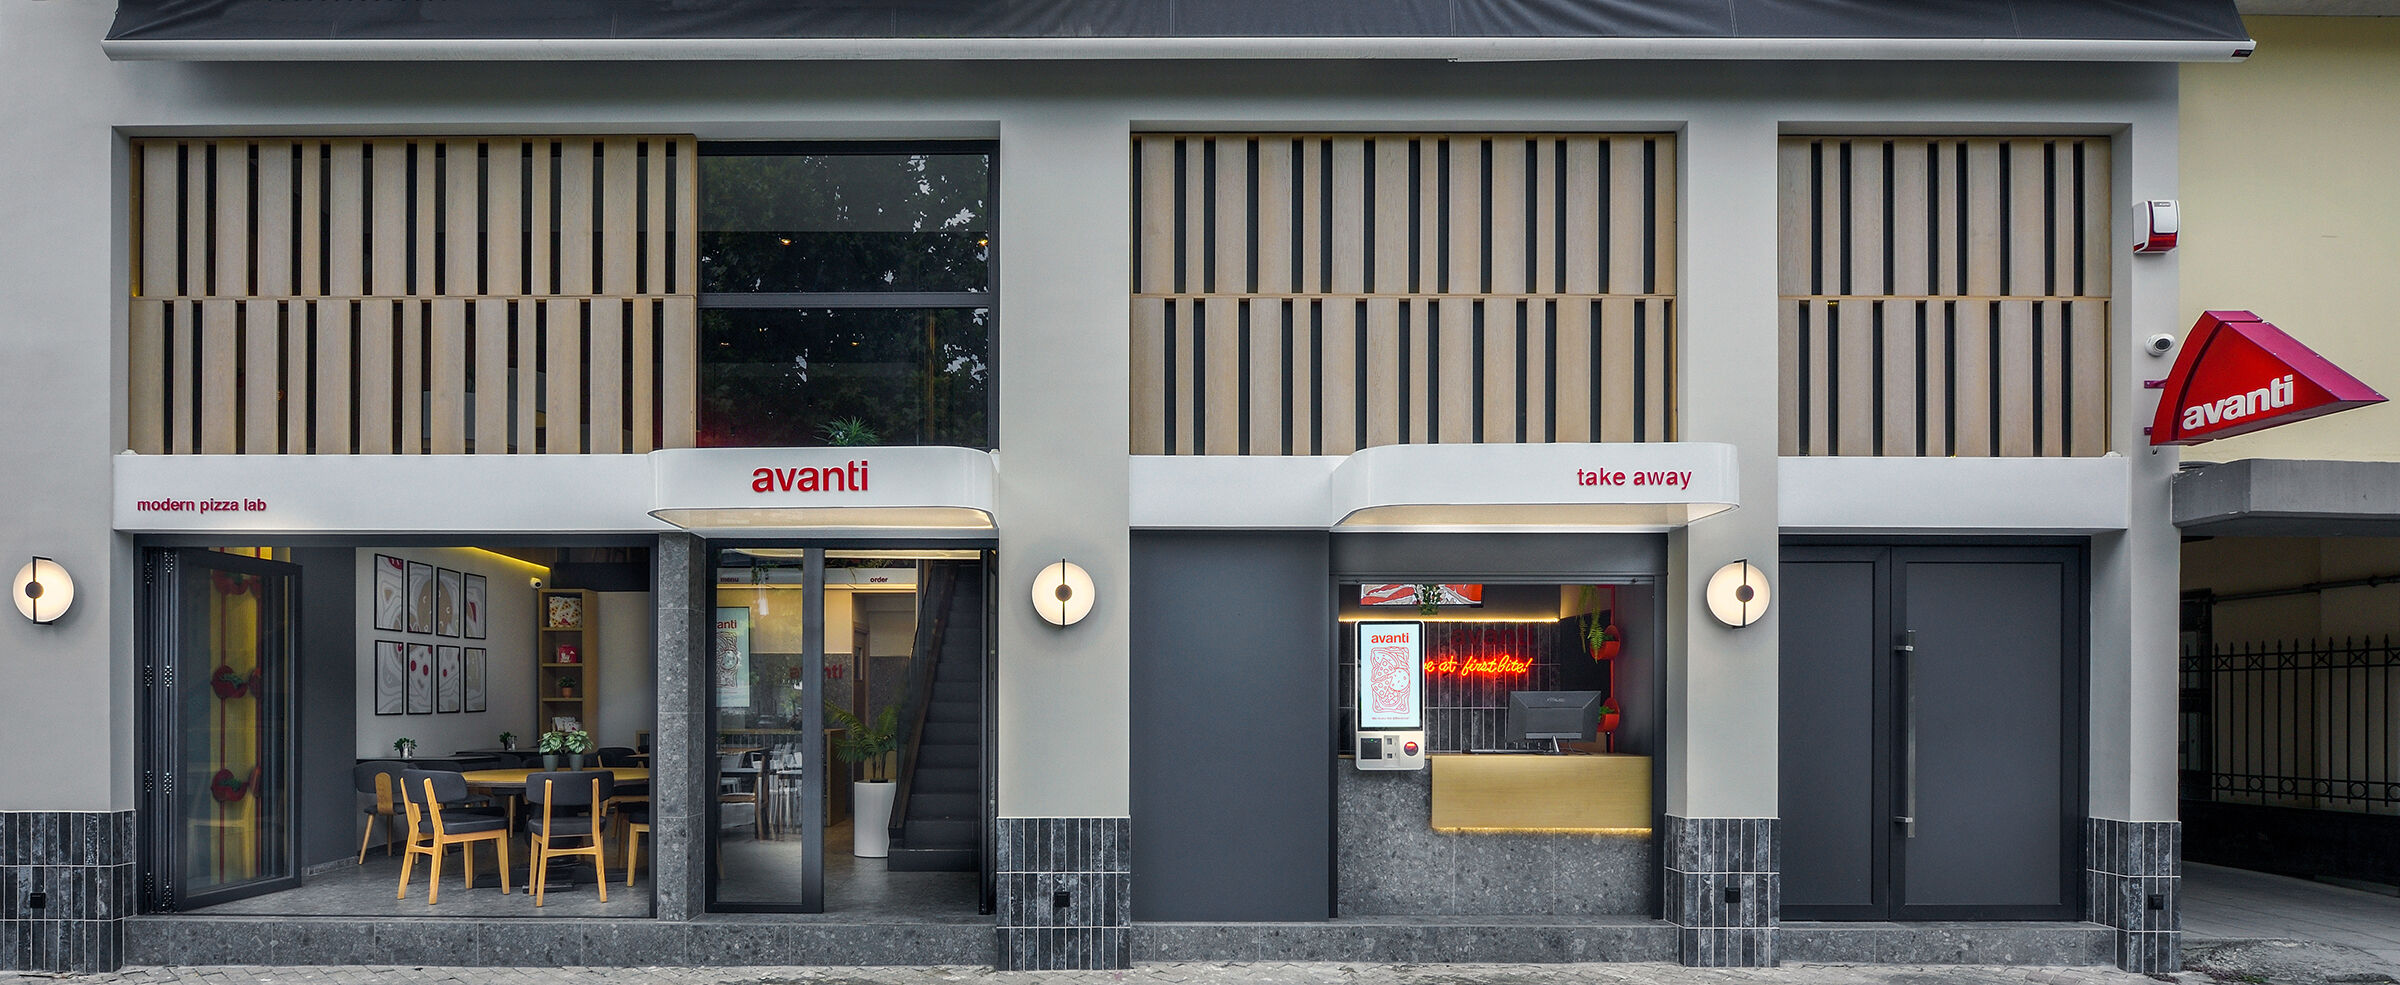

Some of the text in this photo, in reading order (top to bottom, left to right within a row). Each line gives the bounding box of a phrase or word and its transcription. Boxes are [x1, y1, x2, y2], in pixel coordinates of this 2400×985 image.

[2182, 374, 2294, 430] avanti
[751, 460, 869, 493] avanti
[1577, 467, 1692, 491] take away
[137, 498, 267, 514] modern pizza lab
[717, 620, 738, 629] anti
[1371, 632, 1409, 644] avanti
[1450, 625, 1534, 646] avanti
[1439, 655, 1458, 673] at
